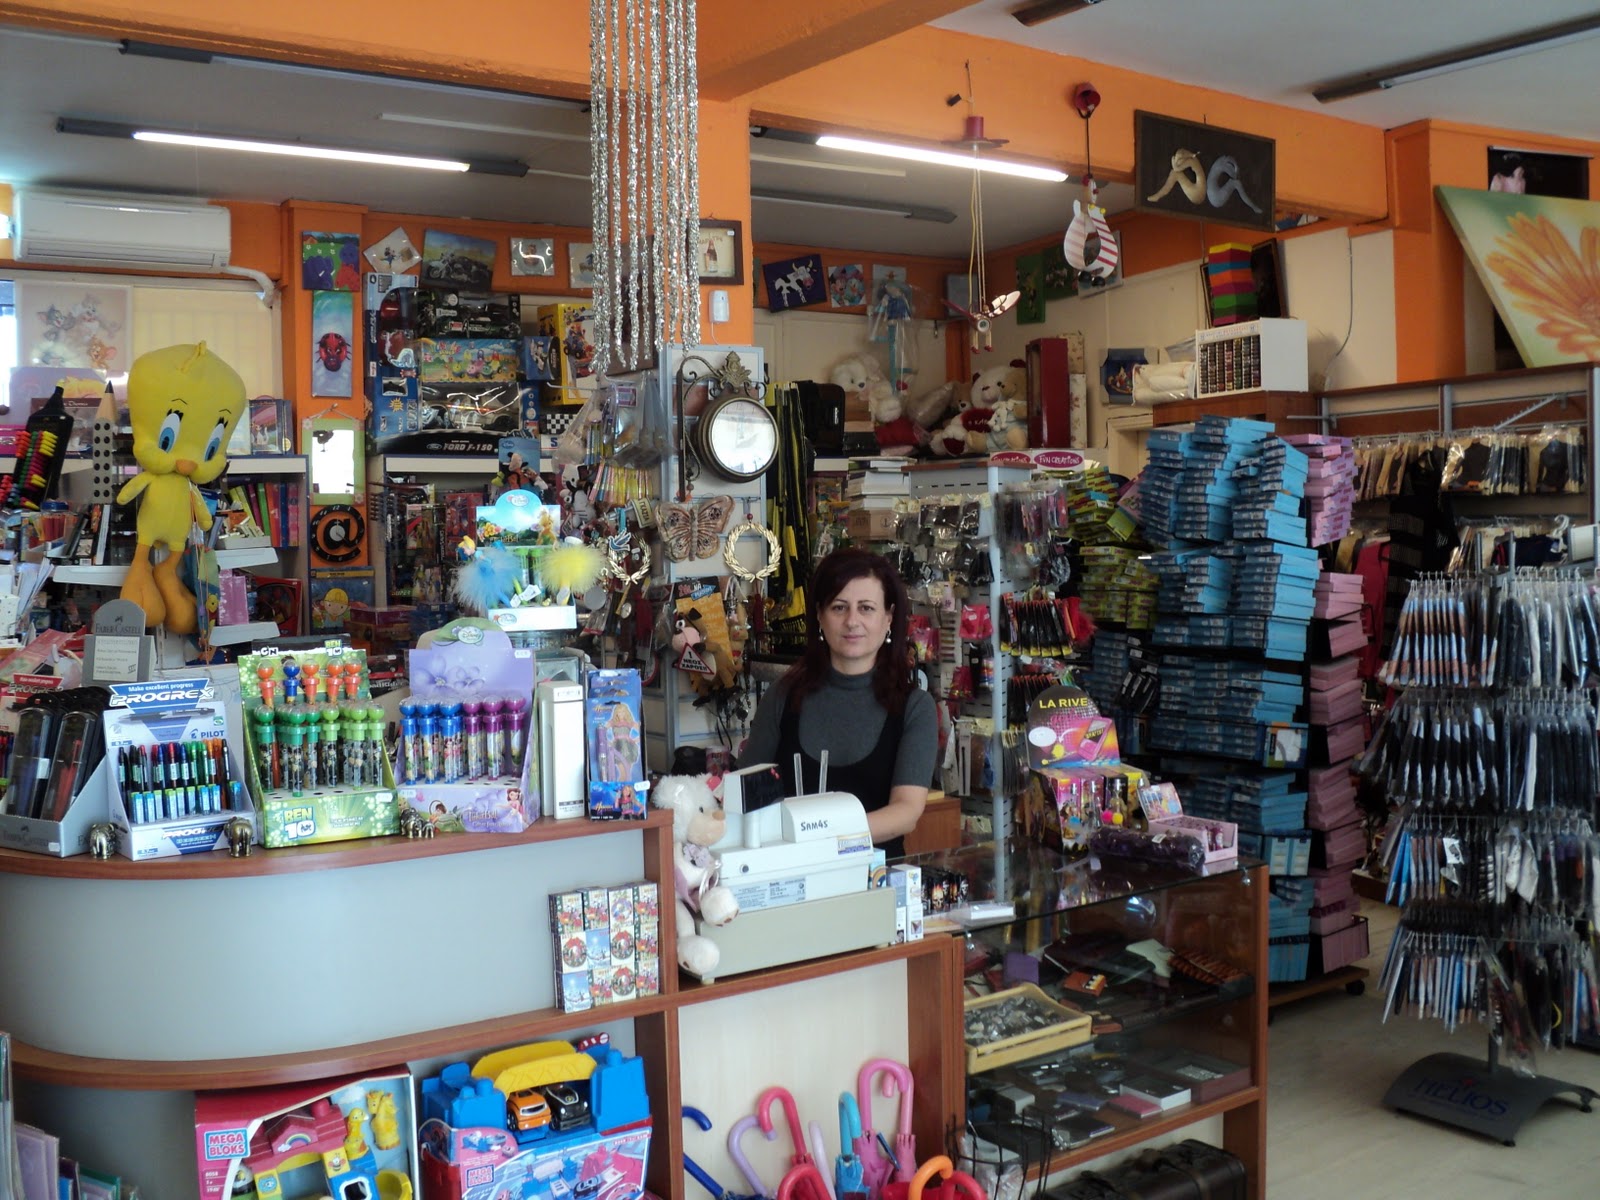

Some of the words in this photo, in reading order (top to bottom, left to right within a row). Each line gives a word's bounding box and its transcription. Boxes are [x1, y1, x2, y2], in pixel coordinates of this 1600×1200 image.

[466, 443, 493, 451] F-150
[170, 682, 194, 690] progress
[110, 687, 214, 706] PROGREX
[1039, 699, 1057, 709] LA
[1059, 697, 1088, 707] RIVE
[200, 730, 225, 738] PILOT
[283, 807, 313, 822] BEN
[284, 819, 316, 840] 10
[209, 1132, 244, 1145] MEGA
[209, 1144, 245, 1156] BLOKS
[469, 1167, 492, 1177] MEGA
